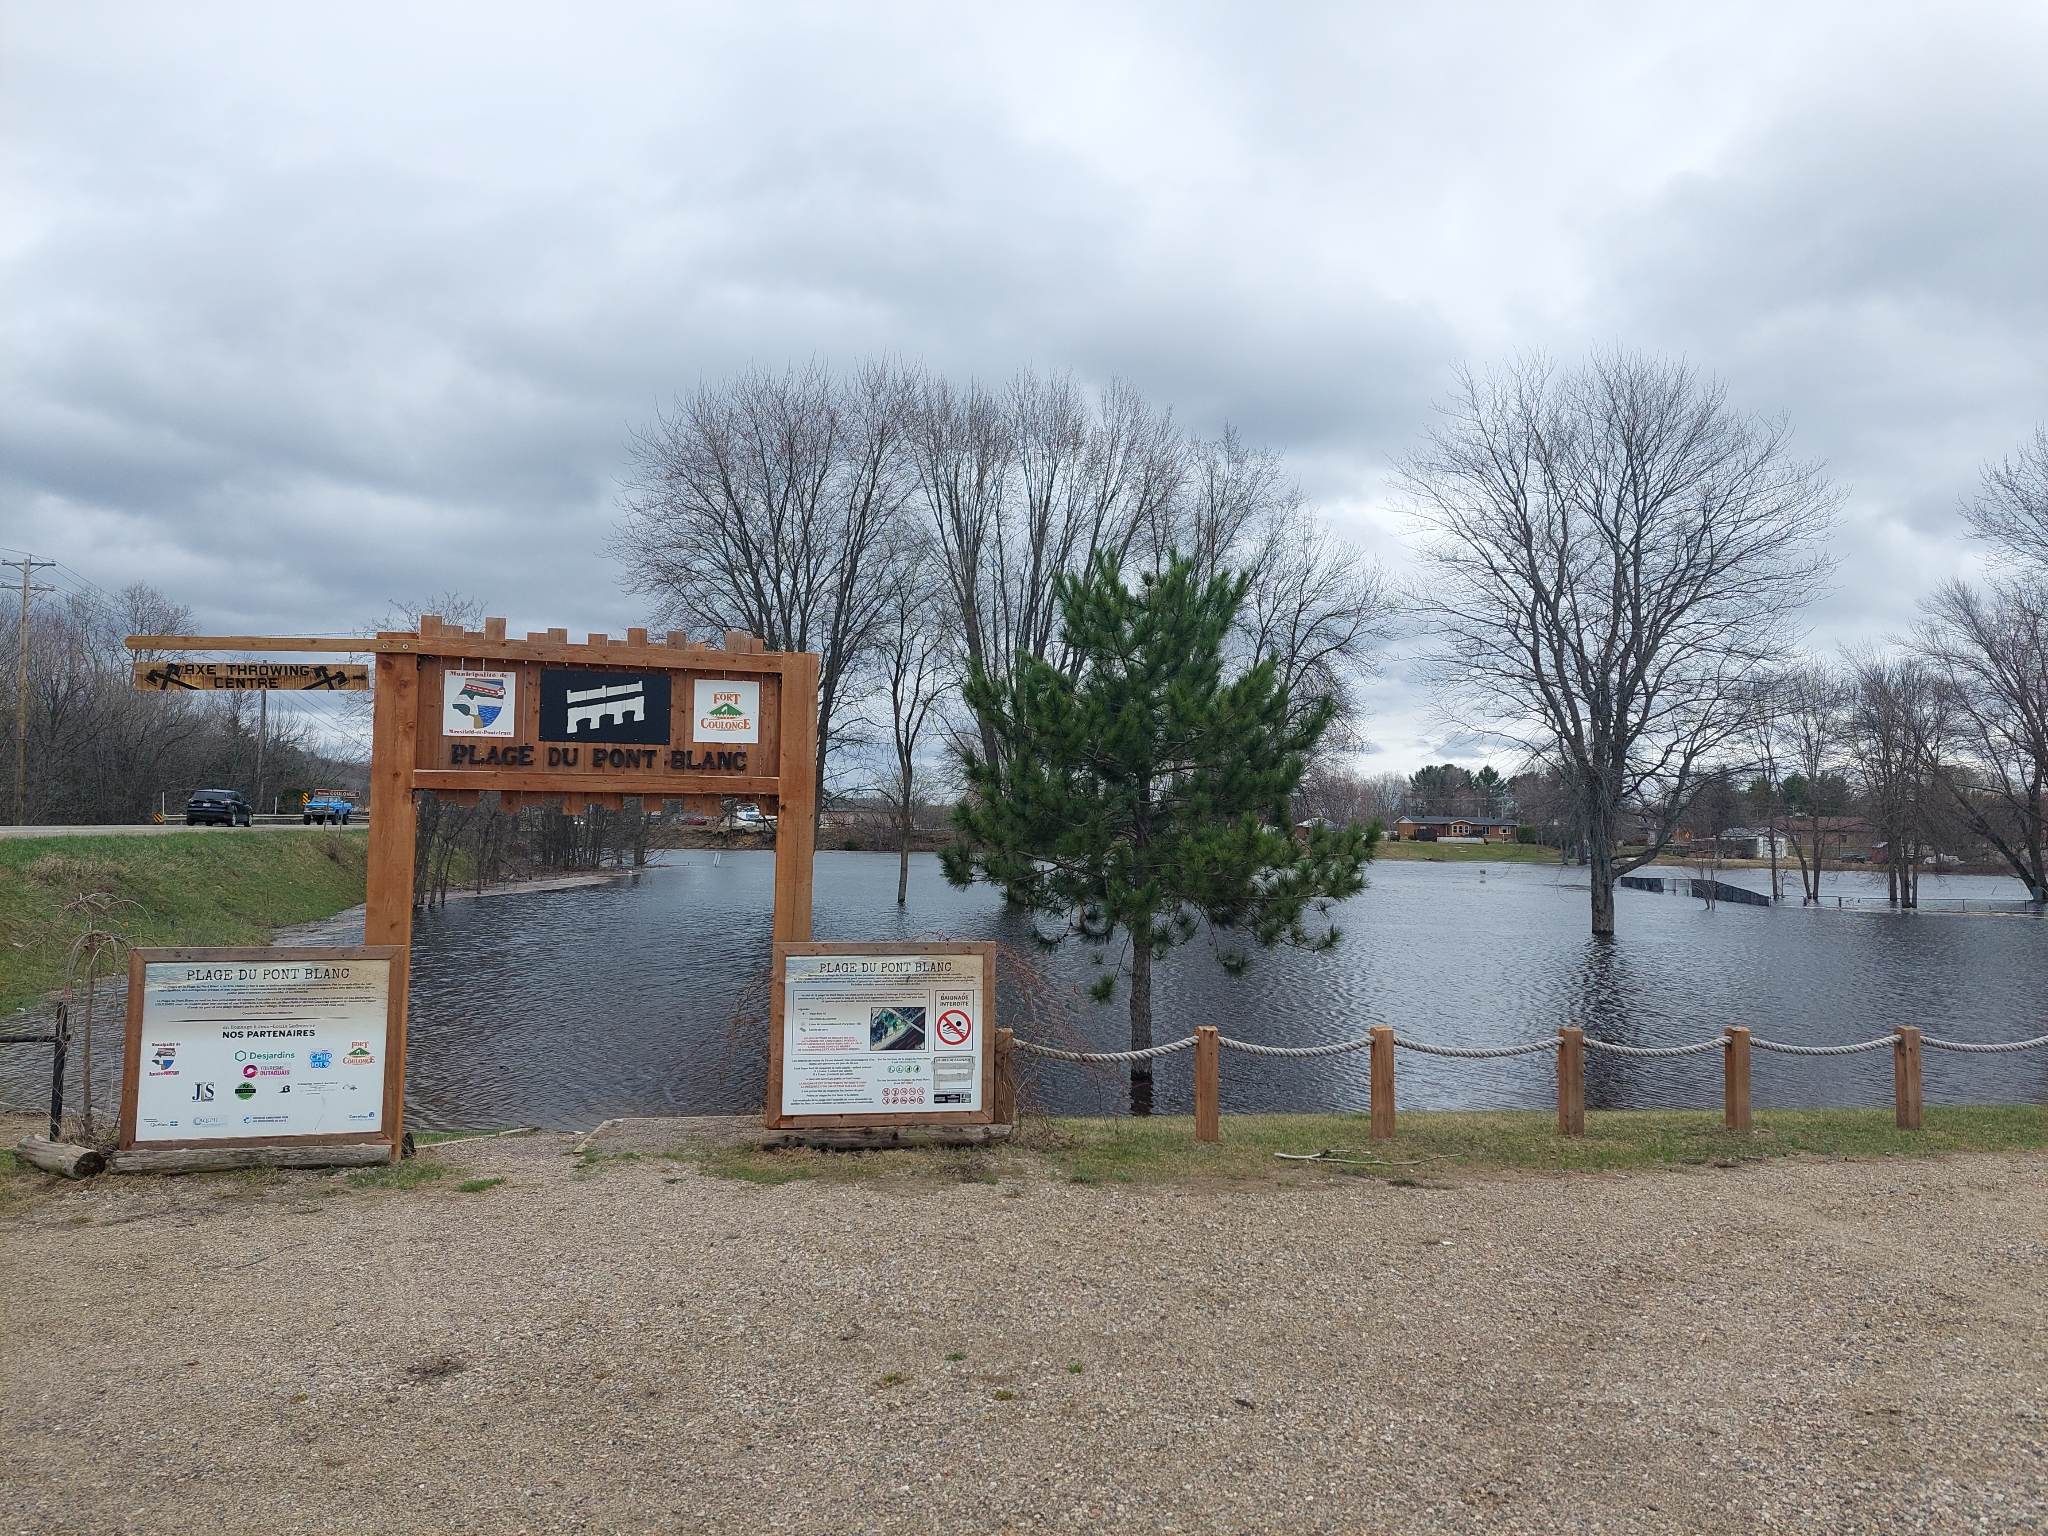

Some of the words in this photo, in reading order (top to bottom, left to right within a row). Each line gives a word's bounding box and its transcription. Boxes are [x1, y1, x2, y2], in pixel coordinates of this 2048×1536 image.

[185, 664, 216, 675] AXE
[226, 664, 309, 676] THROWING
[214, 677, 278, 689] CENTRE
[713, 693, 741, 704] FORT
[700, 717, 751, 730] COULONGE
[451, 744, 534, 766] PLAGE
[547, 747, 579, 767] DU
[592, 748, 658, 769] PONT
[670, 750, 748, 771] BLANC
[819, 962, 857, 973] PLAGE
[862, 962, 876, 973] DU
[880, 962, 911, 973] PONT
[915, 961, 952, 972] BLANC
[187, 969, 233, 981] PLAGE
[238, 969, 257, 980] DU
[263, 968, 300, 980] PONT
[304, 968, 350, 979] BLANC
[222, 1031, 244, 1039] NOS
[247, 1029, 316, 1038] PARTENAIRES
[249, 1051, 295, 1060] Desjardins
[310, 1053, 332, 1061] CHIP
